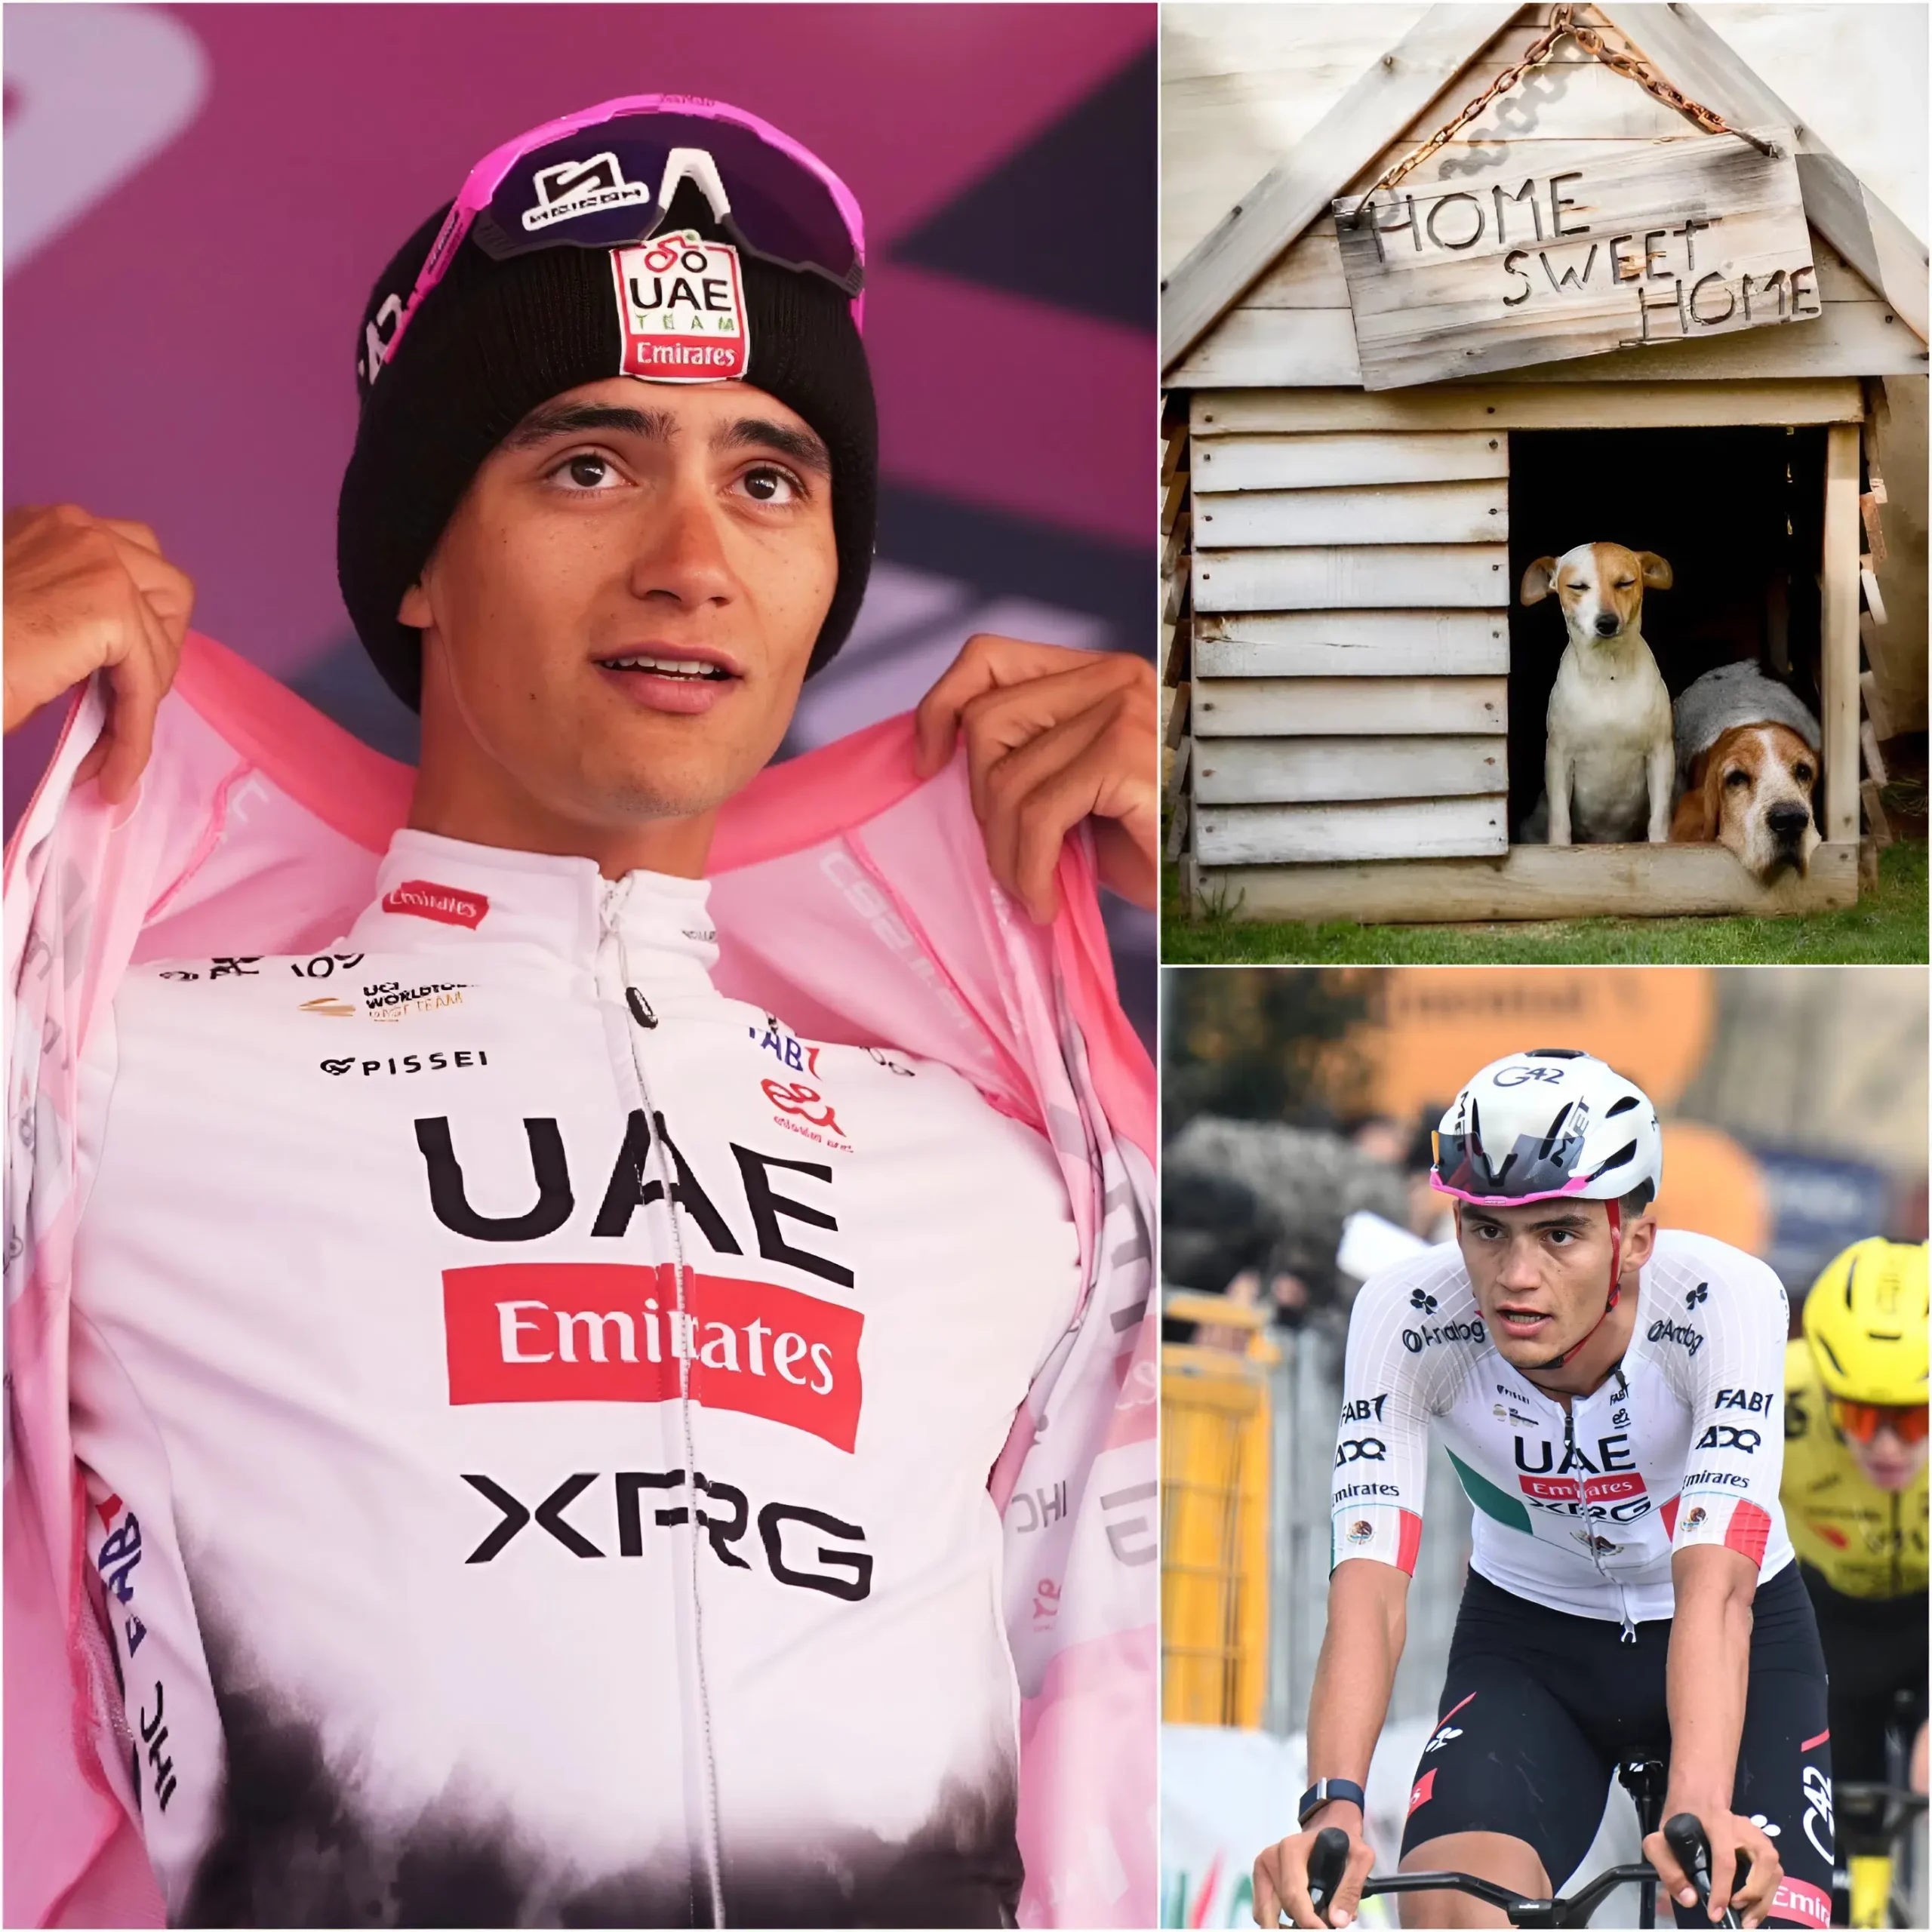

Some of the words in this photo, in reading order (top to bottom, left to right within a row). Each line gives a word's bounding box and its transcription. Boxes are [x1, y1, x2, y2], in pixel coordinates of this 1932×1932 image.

[1368, 171, 1590, 263] HOME
[1503, 220, 1718, 306] SWEET
[629, 278, 731, 311] UAE
[1638, 266, 1820, 340] HOME
[637, 342, 736, 366] Emirates
[362, 1051, 488, 1075] PISSEI
[1494, 1066, 1564, 1087] G42
[1551, 1100, 1590, 1168] MET
[414, 1109, 854, 1288] UAE
[495, 1298, 833, 1395] Emirates
[1715, 1389, 1774, 1419] FAB1
[1515, 1434, 1635, 1473] UAE
[1332, 1483, 1399, 1507] mirates
[460, 1469, 873, 1601] XRG
